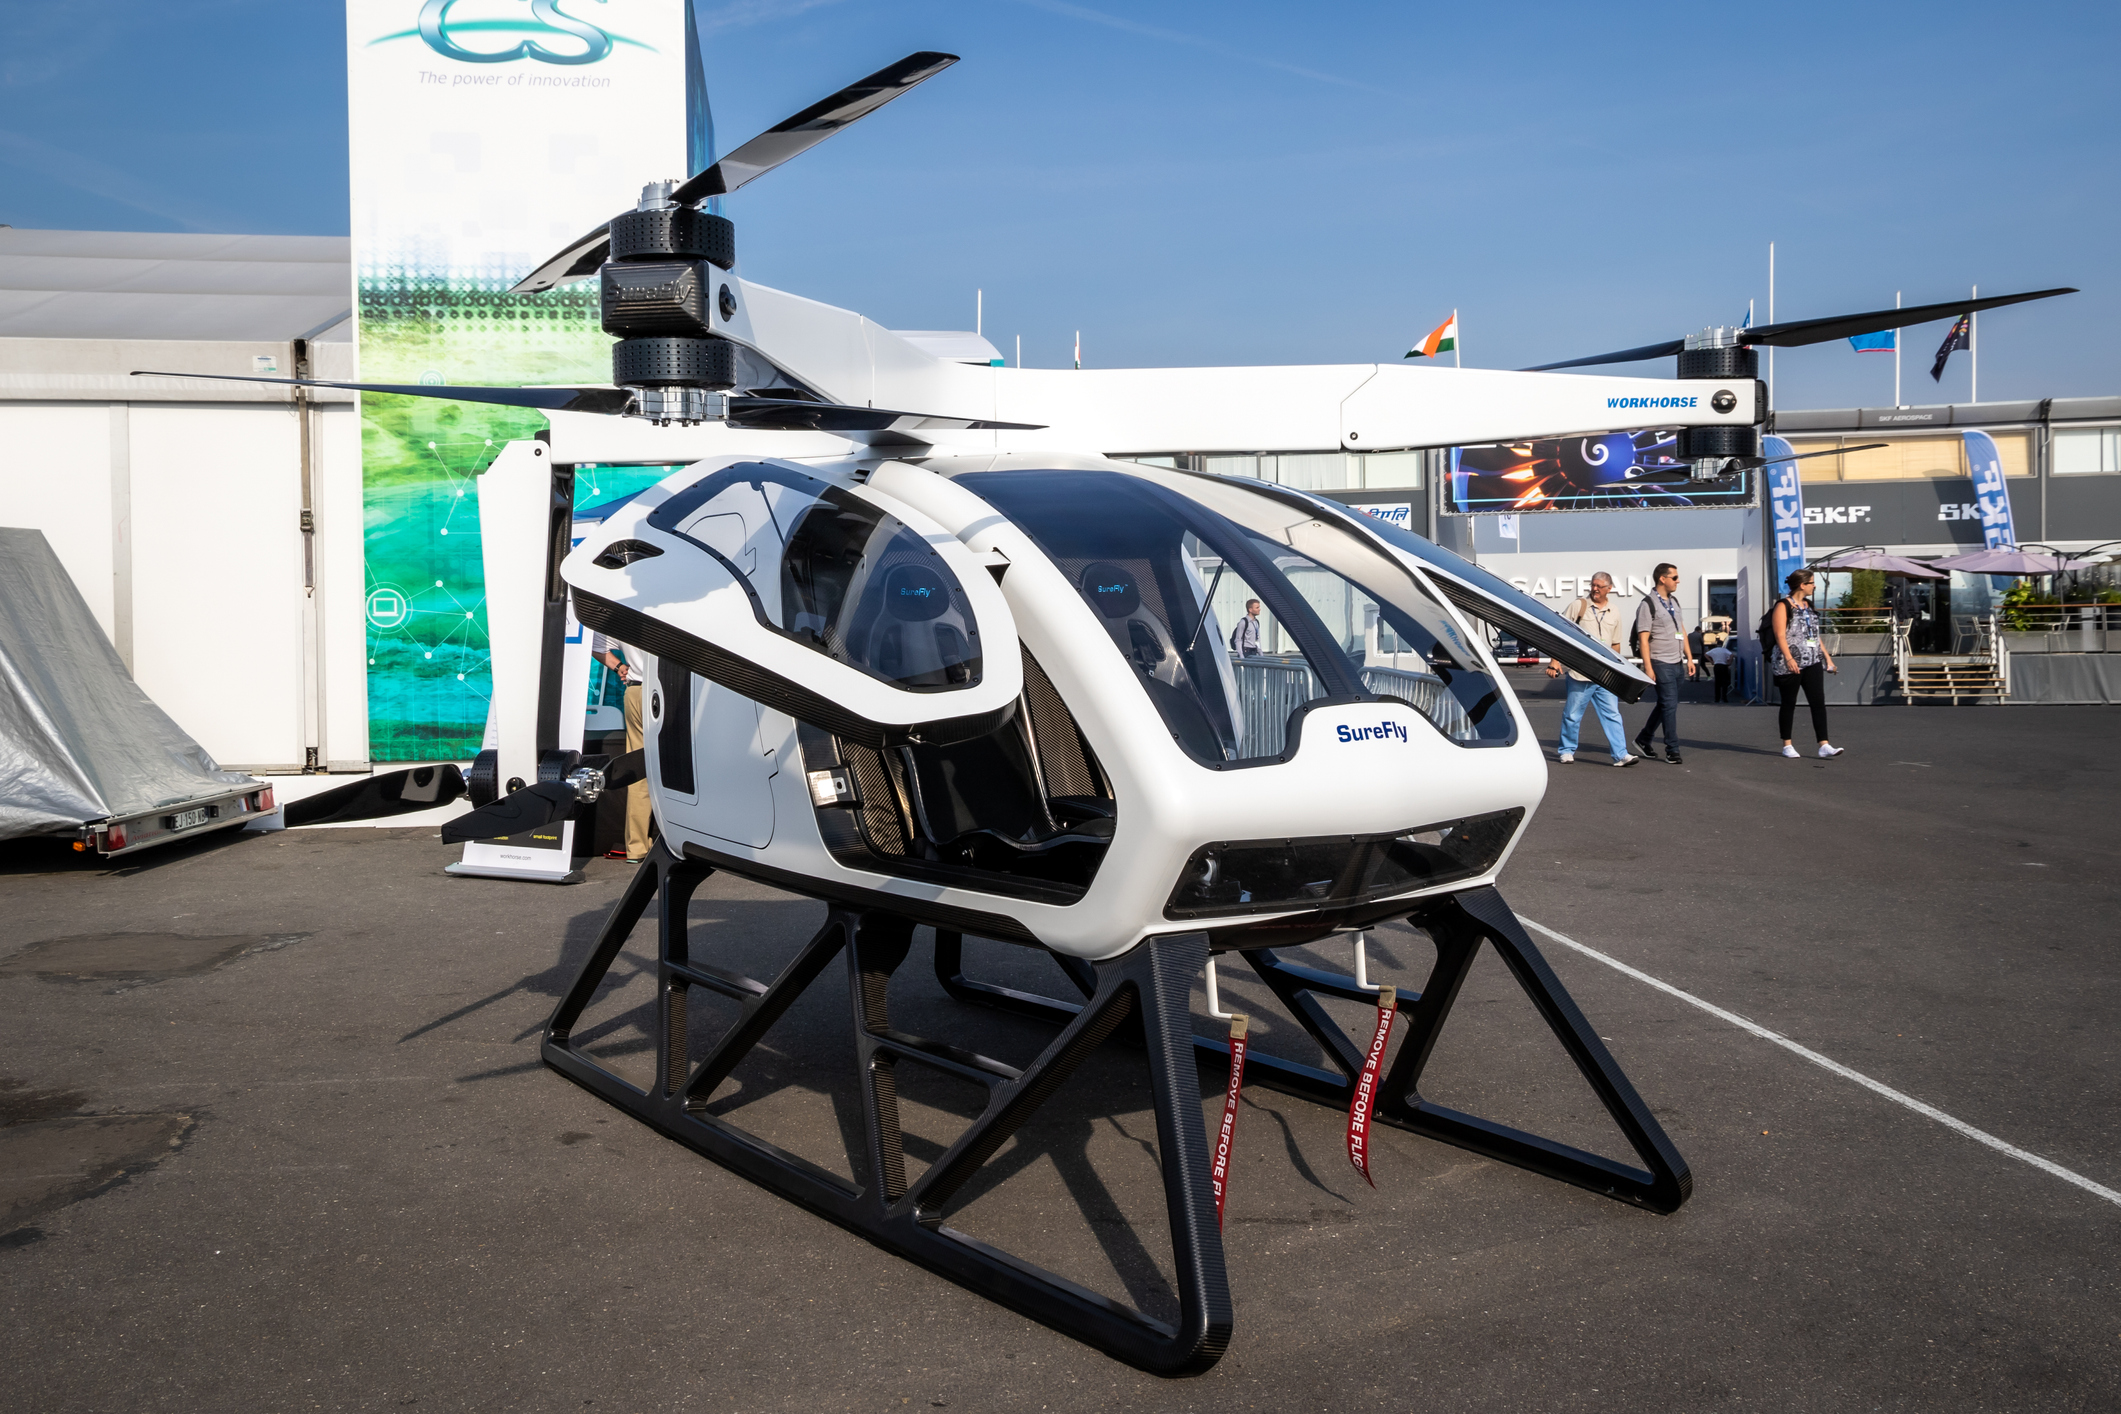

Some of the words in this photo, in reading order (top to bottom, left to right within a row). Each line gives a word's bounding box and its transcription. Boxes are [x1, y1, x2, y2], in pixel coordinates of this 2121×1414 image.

[418, 71, 447, 85] The
[452, 74, 503, 88] power
[507, 73, 525, 86] of
[528, 73, 611, 88] innovation
[606, 279, 693, 305] SureFly
[1607, 397, 1699, 409] WORKHORSE
[1938, 503, 1981, 520] SK
[1098, 584, 1125, 593] SureFly
[1336, 721, 1408, 743] SureFly
[1366, 1008, 1392, 1070] REMOVE
[1227, 1042, 1244, 1110] REMOVE
[1352, 1072, 1373, 1133] BEFORE
[1213, 1112, 1234, 1178] BEFORE
